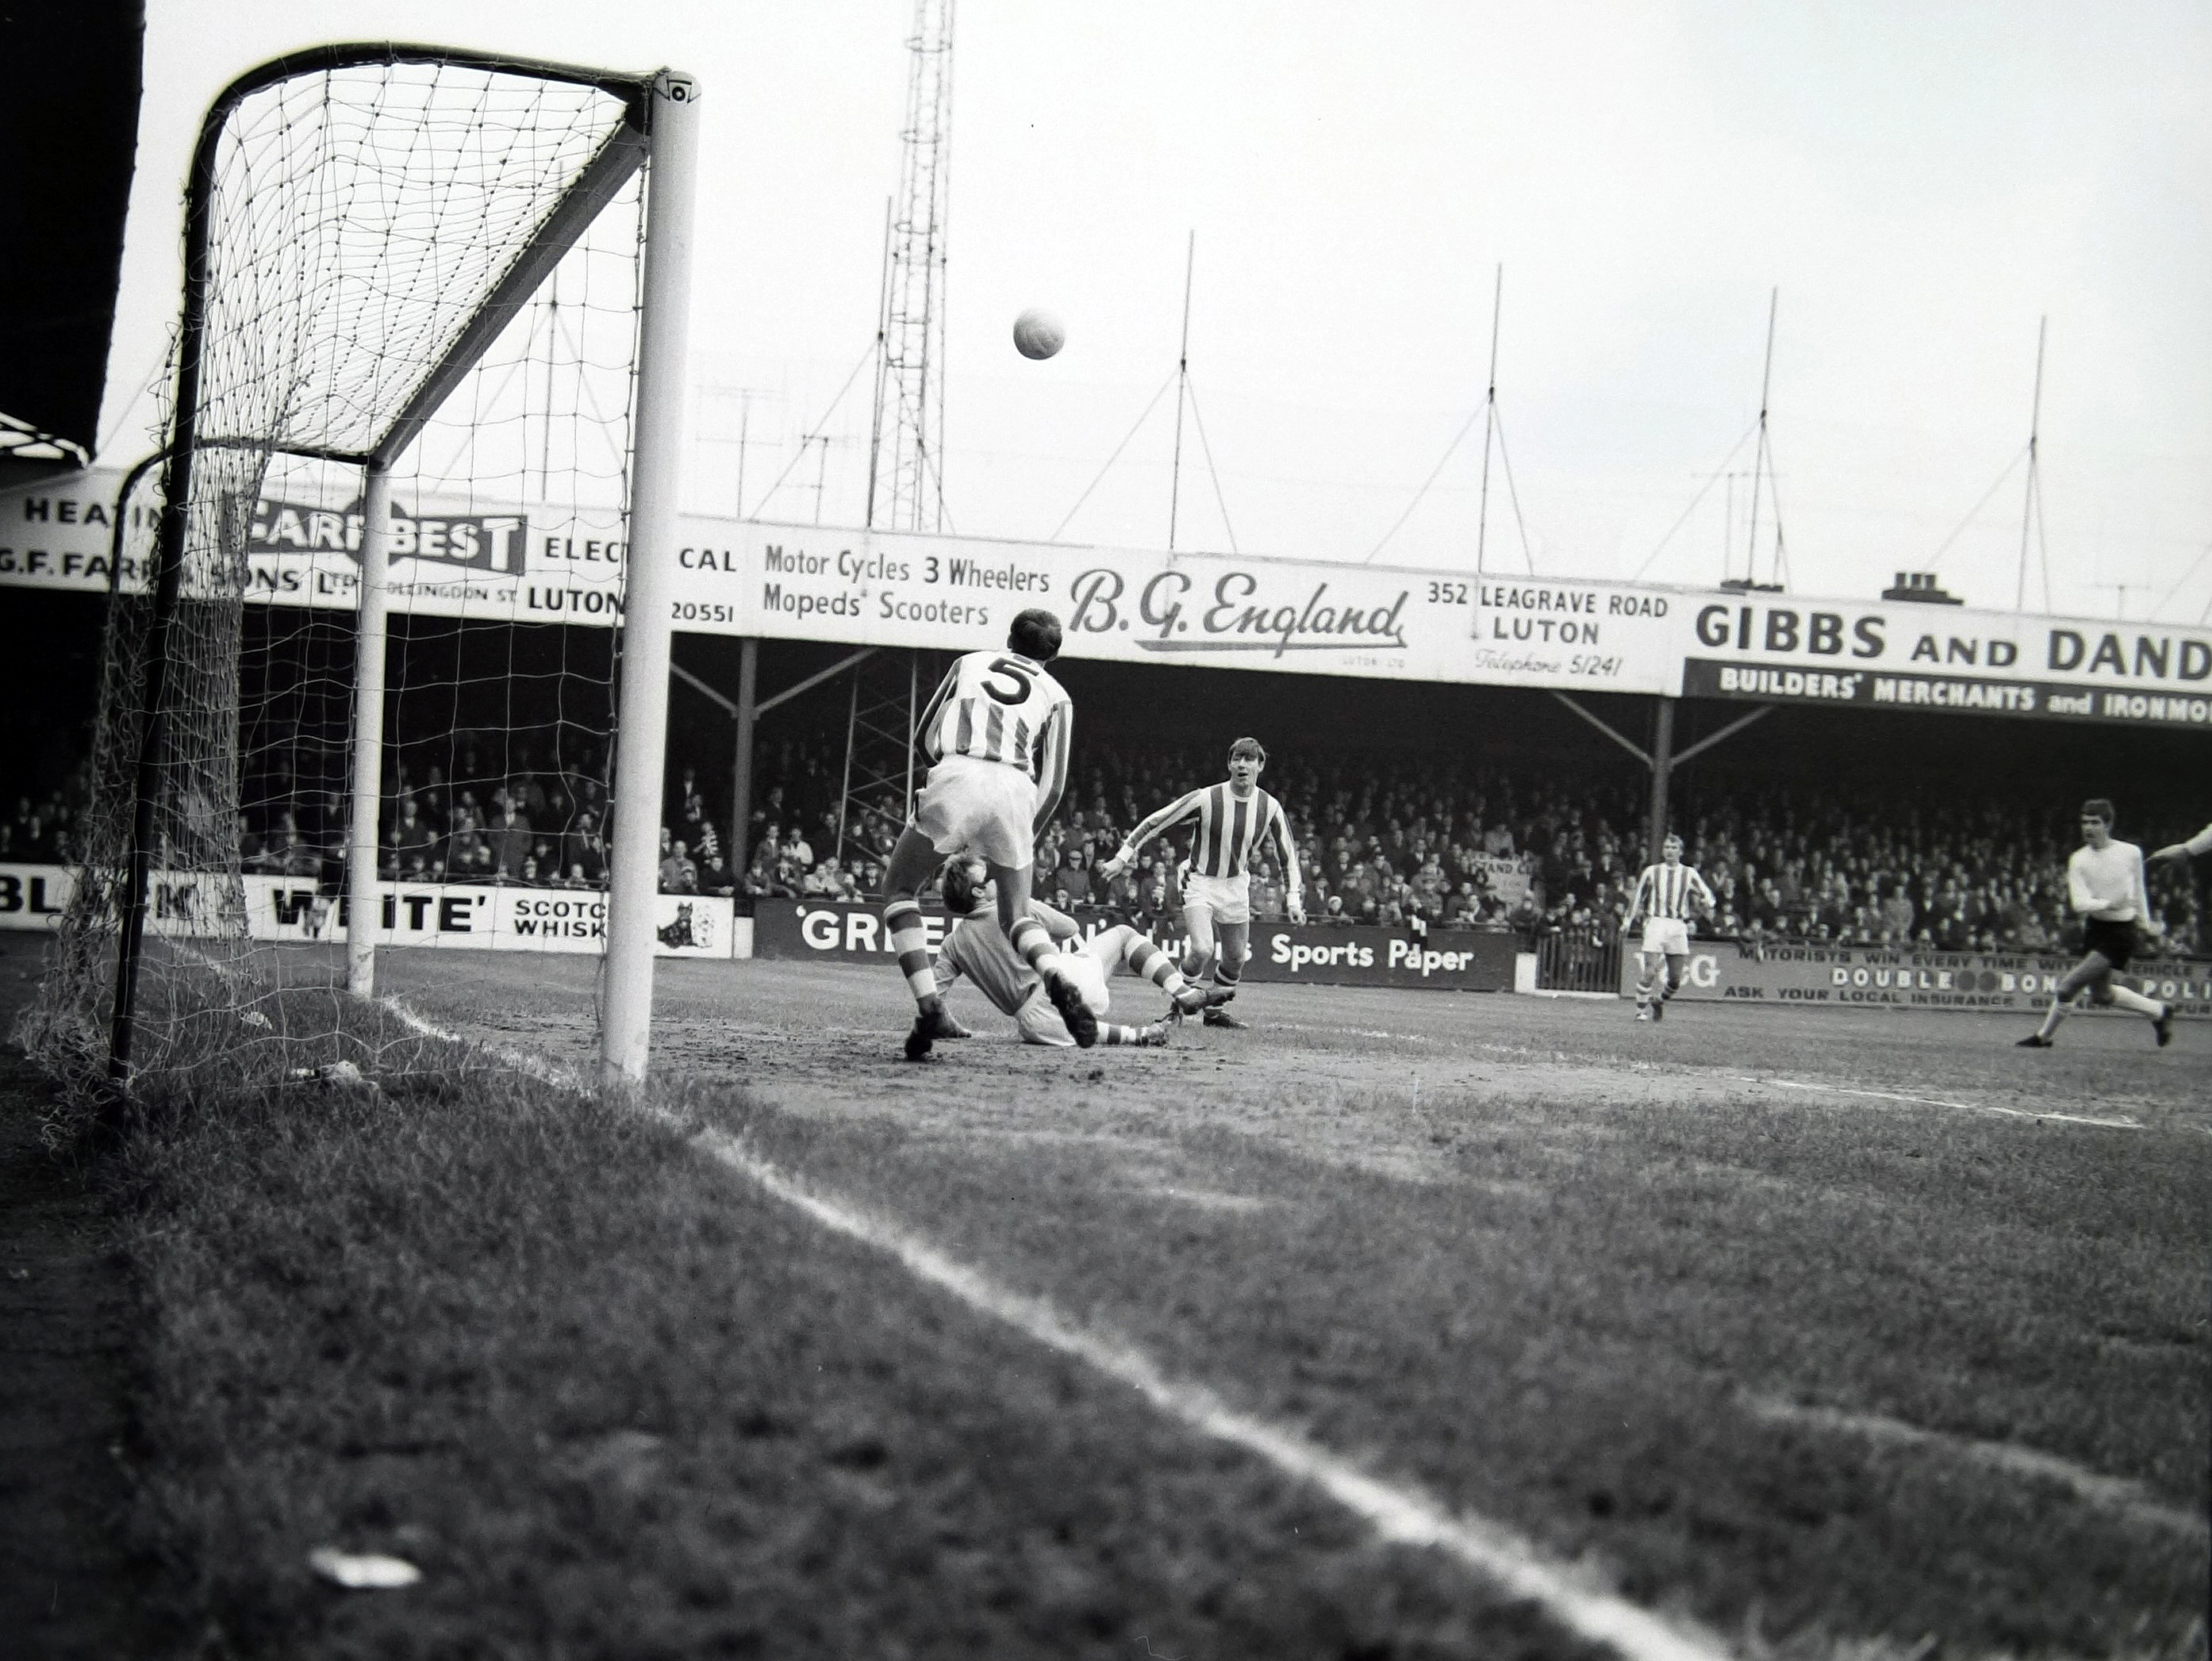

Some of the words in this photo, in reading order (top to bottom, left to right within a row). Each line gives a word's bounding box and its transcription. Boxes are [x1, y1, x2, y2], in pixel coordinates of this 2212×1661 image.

[765, 545, 830, 576] Motor
[838, 550, 910, 585] Cycles
[924, 555, 939, 584] 3
[950, 558, 1050, 593] Wheelers
[528, 586, 624, 616] LUTON
[671, 601, 734, 623] 20551
[879, 592, 989, 626] Scooters
[1203, 572, 1409, 658] England
[1427, 581, 1469, 605] 352
[1480, 585, 1596, 614] LEAGRAVE
[1608, 596, 1669, 618] ROAD
[1492, 616, 1599, 645] LUTON
[1695, 604, 1886, 658] GIBBS
[1910, 634, 2018, 666] AND
[2047, 629, 2212, 681] DAND
[980, 655, 1040, 706] 5
[1719, 667, 1864, 700] BUILDERS'
[1872, 677, 2035, 712] MERCHANTS
[2046, 692, 2093, 714] and
[2104, 693, 2212, 725] IRONMO
[273, 889, 486, 932] WITE'
[515, 900, 607, 919] SCOTC
[514, 919, 608, 938] WHISK
[1271, 933, 1375, 972] Sports
[1388, 938, 1475, 978] Paper
[1723, 985, 1764, 999] ASK
[1777, 988, 1829, 1001] YOUR
[1839, 991, 1902, 1004] LOCAL
[1911, 993, 2014, 1007] INSURANCE
[1831, 967, 1953, 991] DOUBLE
